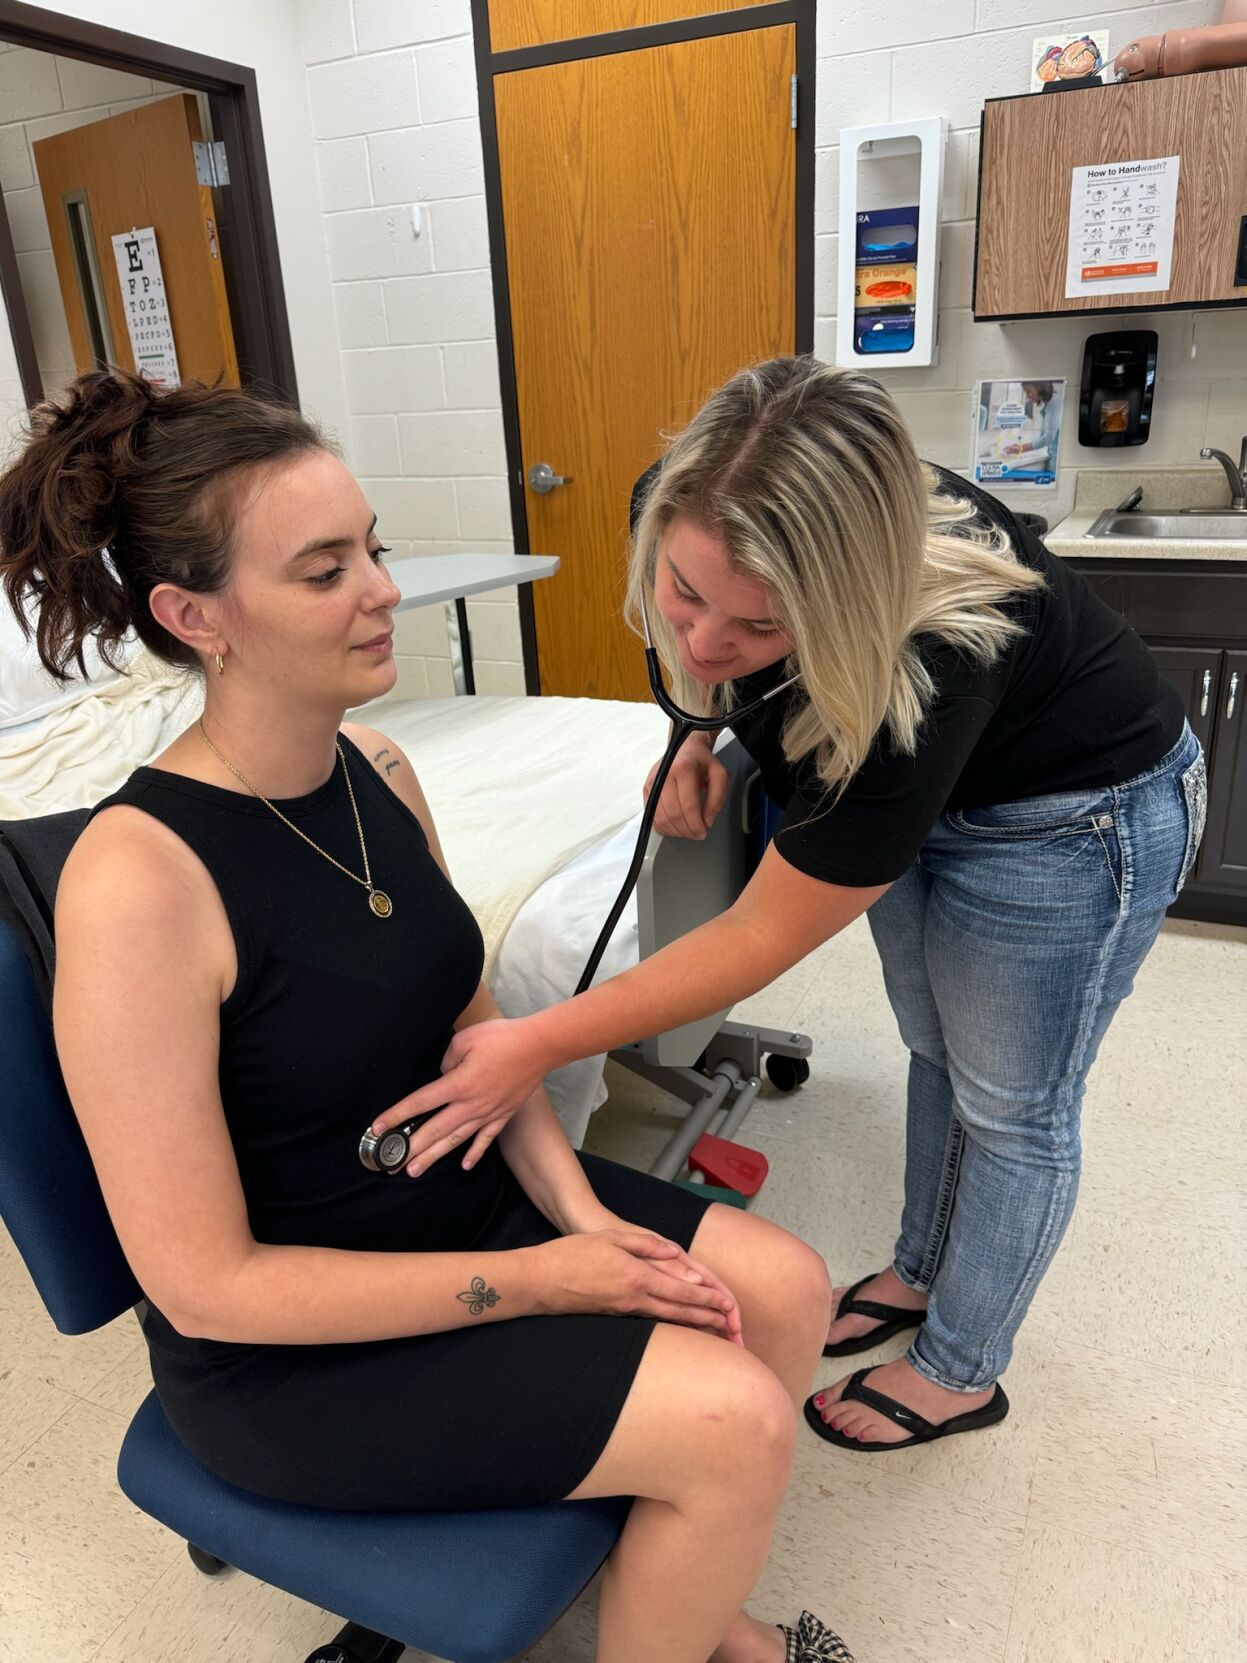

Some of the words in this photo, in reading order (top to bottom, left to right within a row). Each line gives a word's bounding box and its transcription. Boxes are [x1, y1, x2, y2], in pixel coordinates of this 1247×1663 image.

[1087, 170, 1106, 178] How
[1108, 168, 1117, 176] to
[1118, 161, 1168, 175] Handwash?
[857, 214, 870, 223] RA
[124, 240, 143, 273] E
[872, 267, 906, 277] Orange
